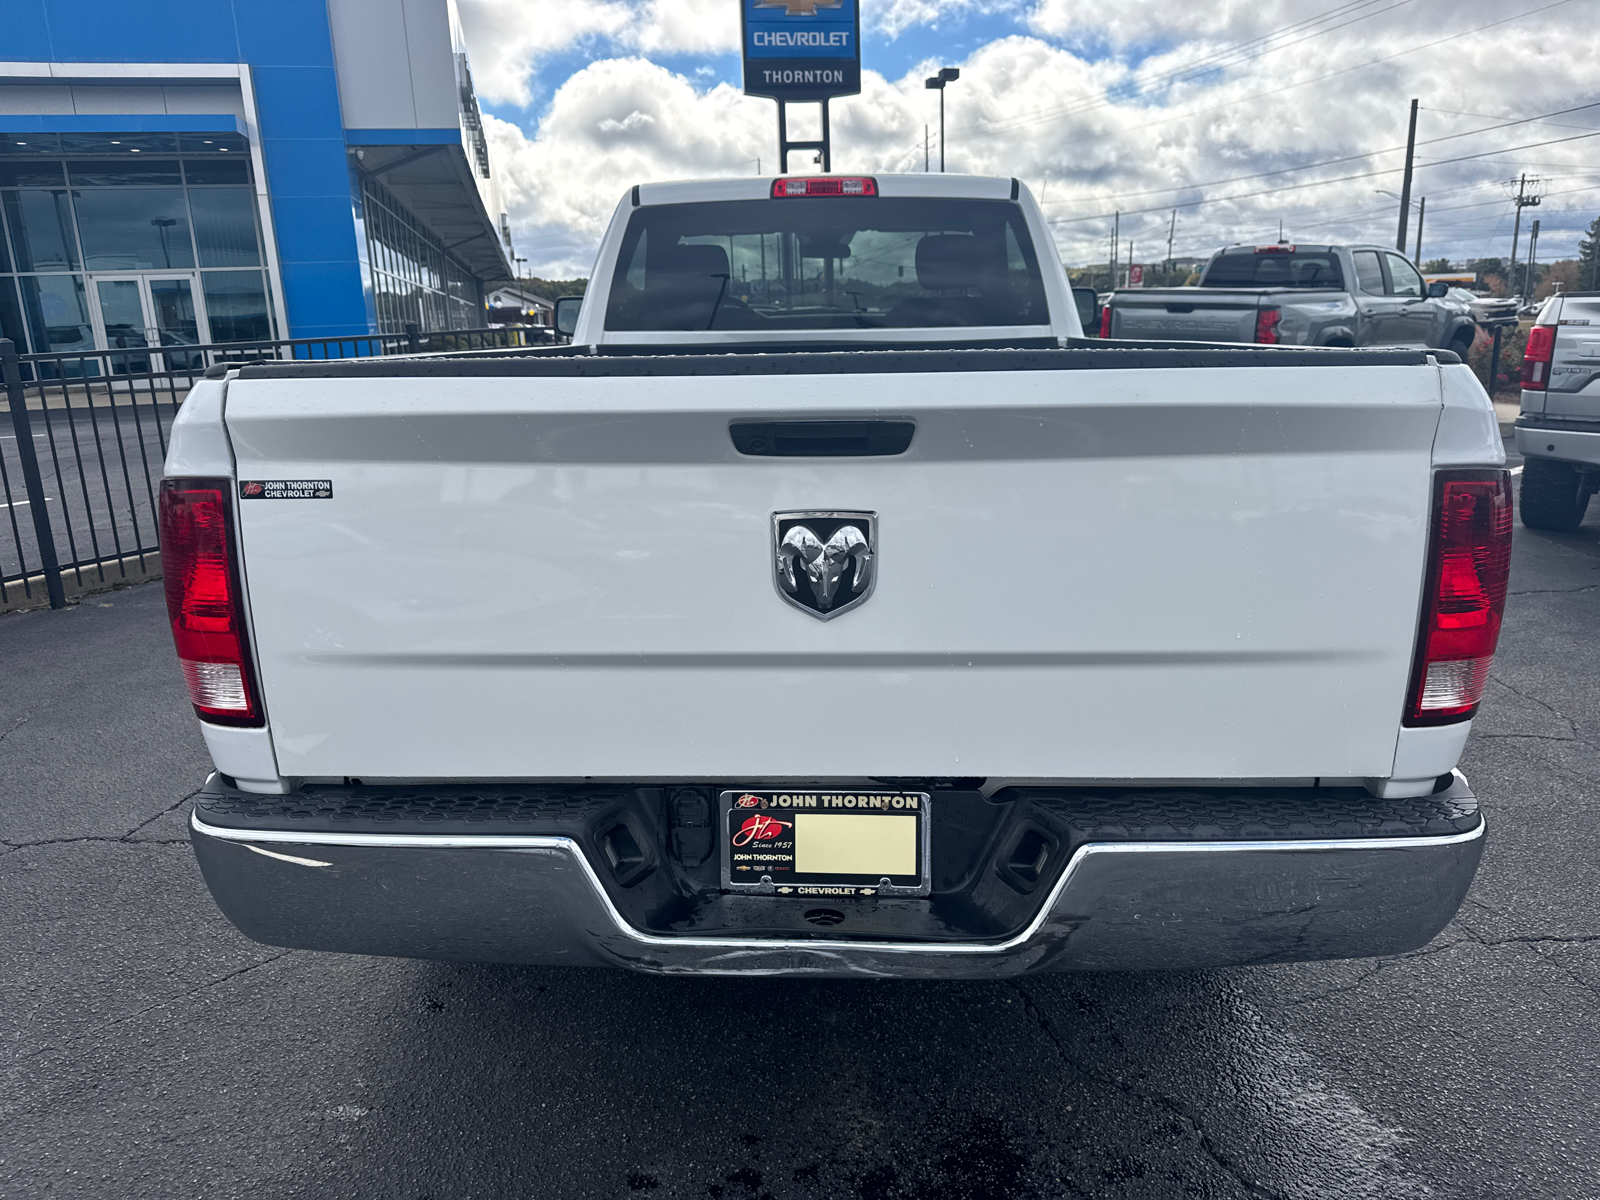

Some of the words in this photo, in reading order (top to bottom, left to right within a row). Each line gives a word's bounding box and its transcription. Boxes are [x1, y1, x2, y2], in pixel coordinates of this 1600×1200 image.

[753, 31, 850, 47] CHEVROLET
[763, 70, 844, 84] THORNTON
[1122, 319, 1237, 332] CHEVROLET
[264, 481, 286, 490] JOHN
[286, 481, 330, 490] THORNTON
[264, 490, 315, 498] CHEVROLET
[769, 794, 817, 808] JOHN
[821, 795, 918, 809] THORNTON
[751, 841, 773, 849] Since
[773, 841, 793, 849] 1957
[733, 853, 753, 861] JOHN
[752, 853, 793, 862] THORNTON
[797, 887, 857, 895] CHEVROLET
